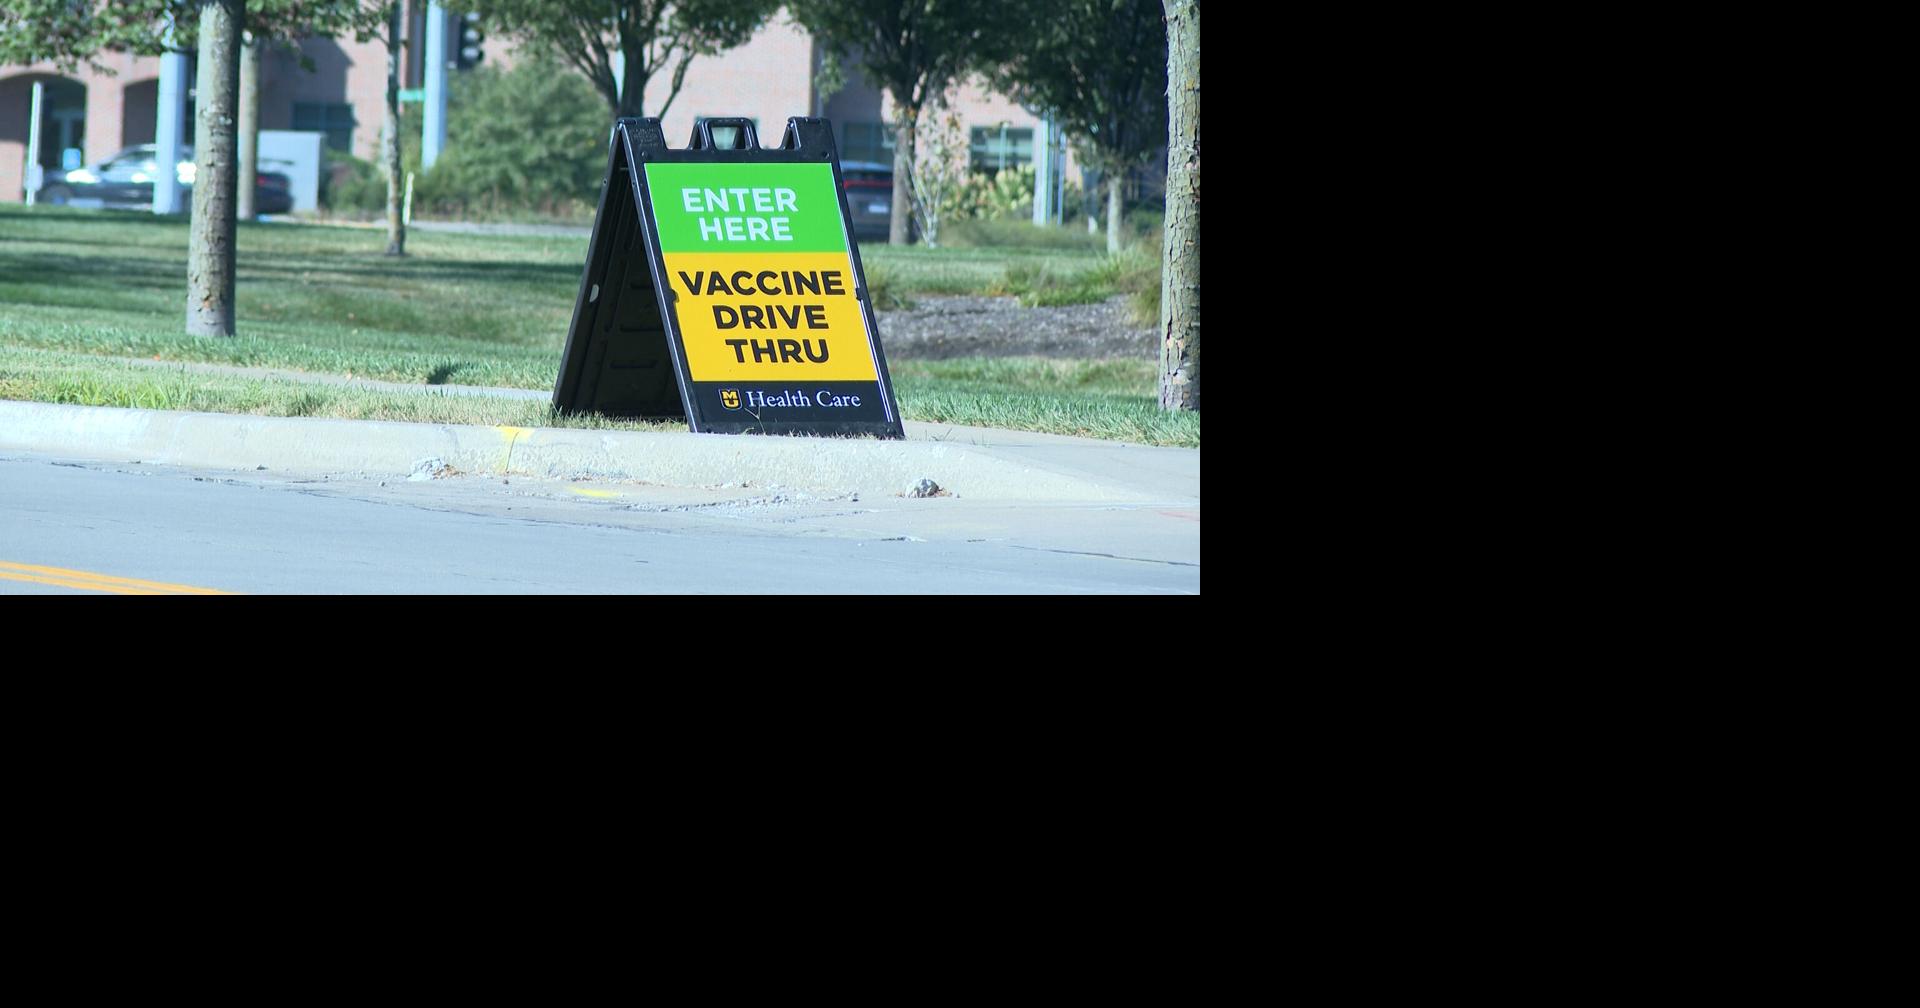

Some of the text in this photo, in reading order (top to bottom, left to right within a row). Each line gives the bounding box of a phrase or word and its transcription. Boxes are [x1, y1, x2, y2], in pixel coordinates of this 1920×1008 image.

[681, 188, 798, 213] ENTER
[699, 217, 794, 241] HERE
[678, 271, 846, 296] VACCINE
[712, 305, 829, 330] DRIVE
[725, 339, 830, 364] THRU
[745, 390, 811, 408] Health
[816, 390, 862, 408] Care
